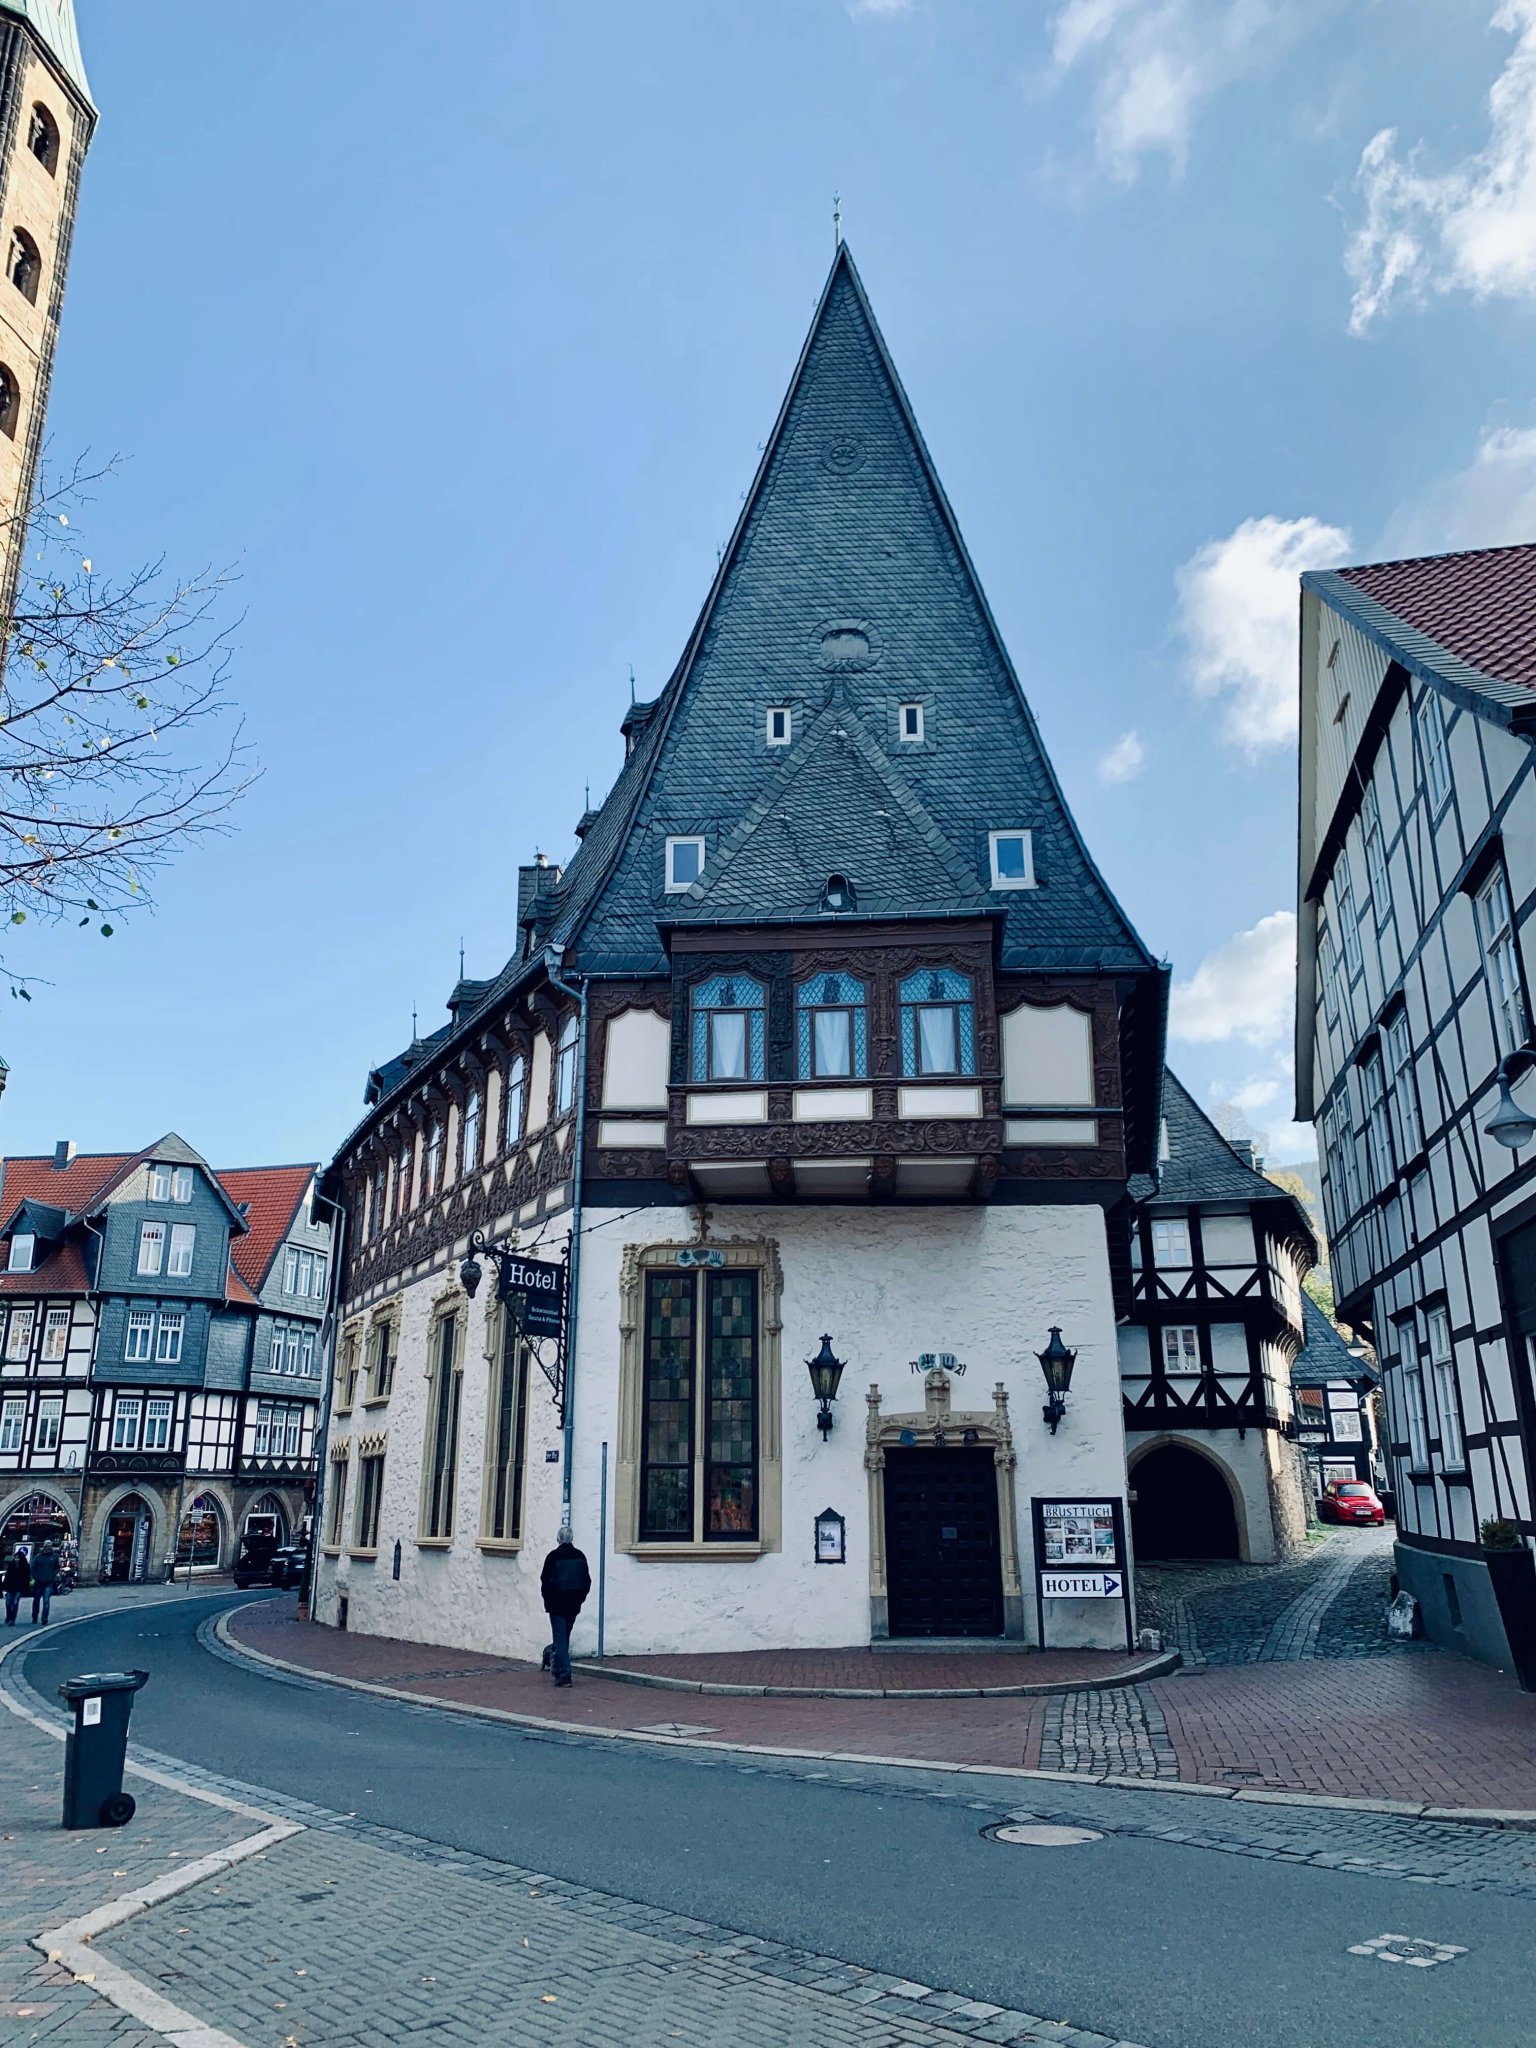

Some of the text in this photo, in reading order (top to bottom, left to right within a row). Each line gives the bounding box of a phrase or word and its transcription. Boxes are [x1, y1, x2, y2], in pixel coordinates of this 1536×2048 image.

[509, 1263, 557, 1290] Hotel
[1046, 1507, 1110, 1517] BRUSTTUCH
[1046, 1579, 1113, 1592] HOTEL P
